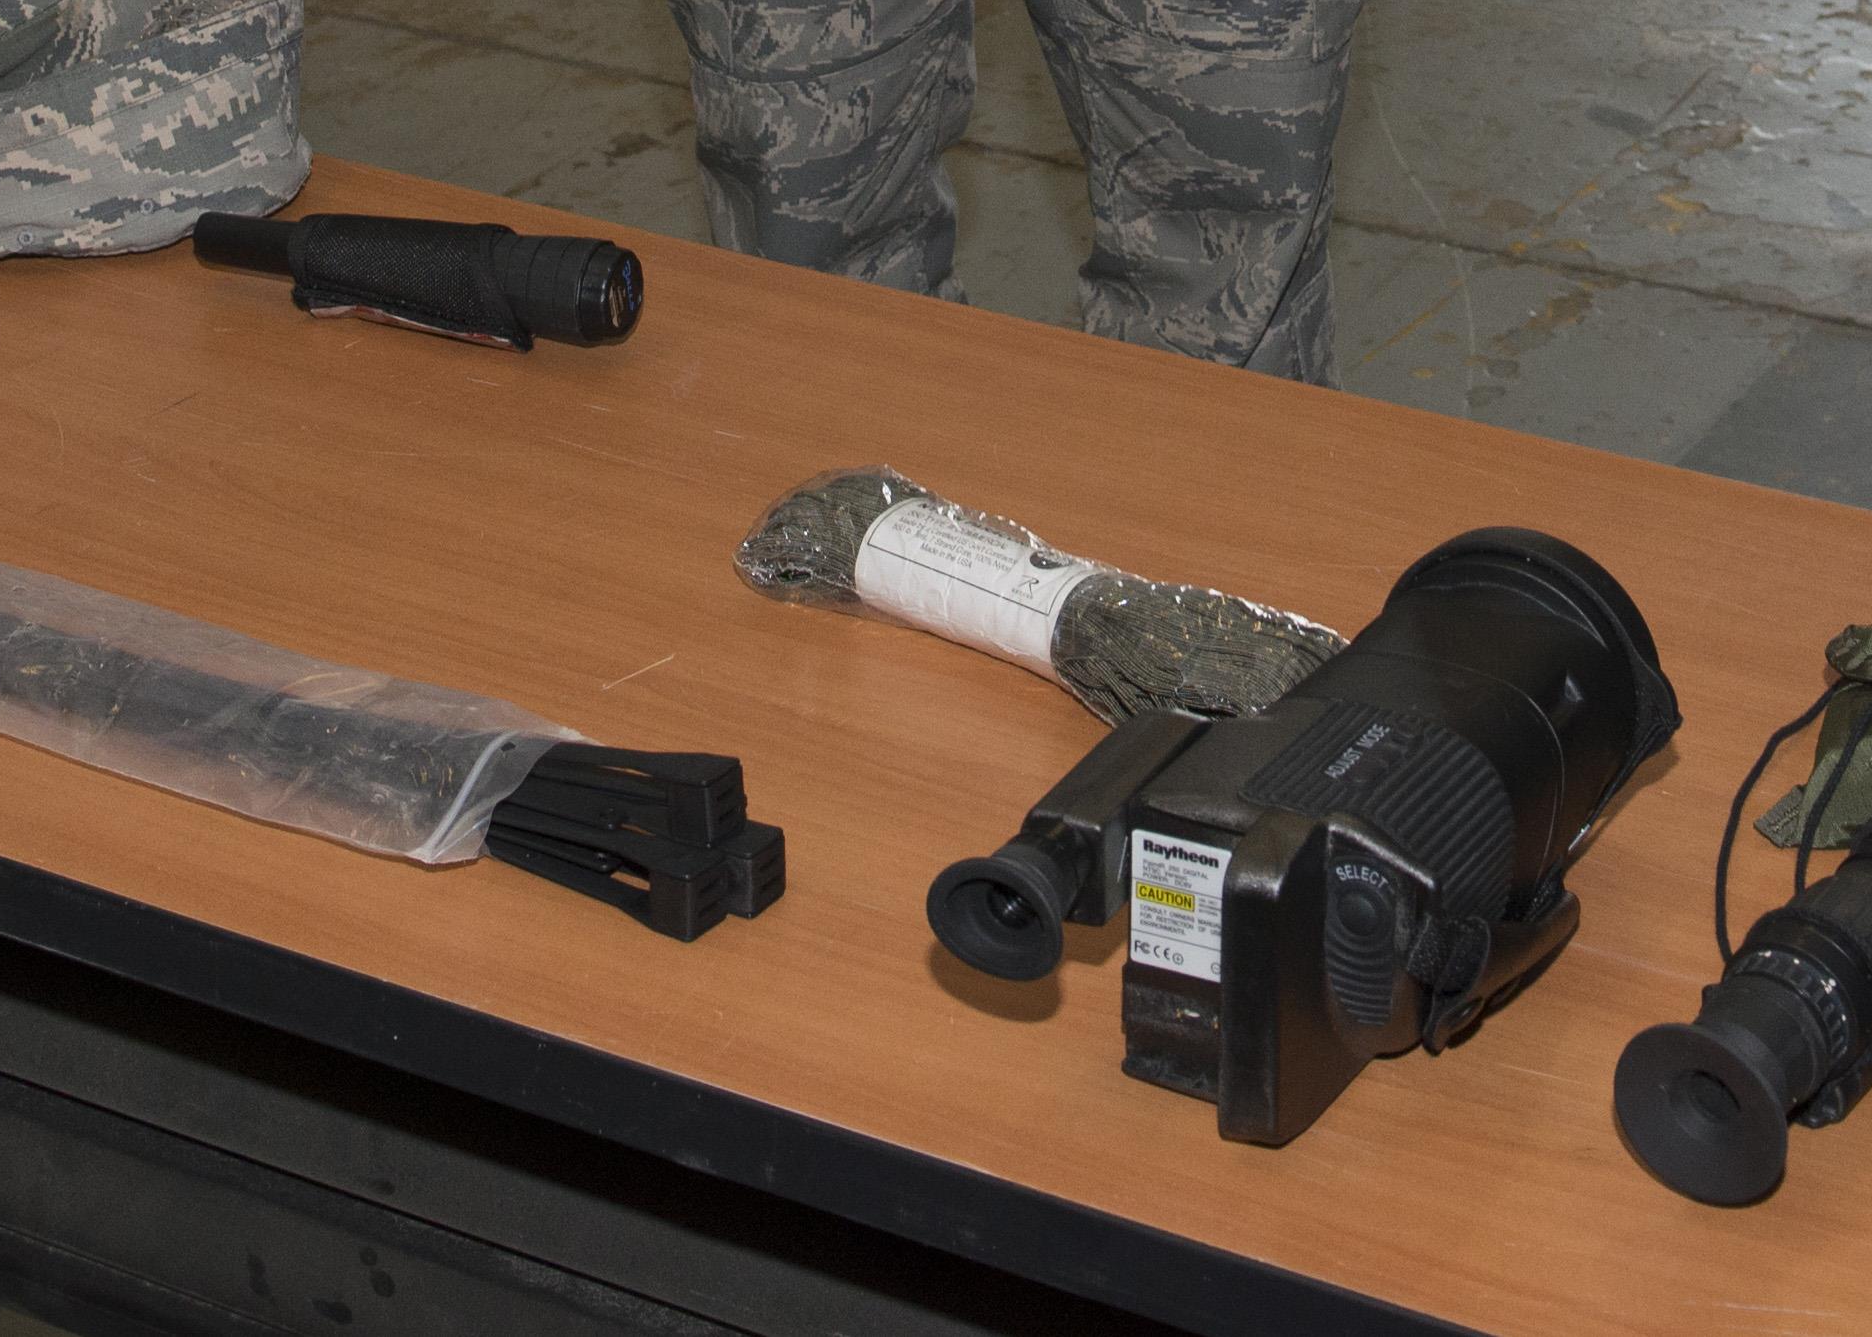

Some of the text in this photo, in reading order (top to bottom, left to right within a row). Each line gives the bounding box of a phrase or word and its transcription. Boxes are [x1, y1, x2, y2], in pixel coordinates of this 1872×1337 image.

[1325, 724, 1391, 779] ADJUST MODE
[1143, 838, 1219, 869] Raytheon
[1336, 864, 1389, 889] SELECT
[1139, 886, 1193, 909] CAUTION
